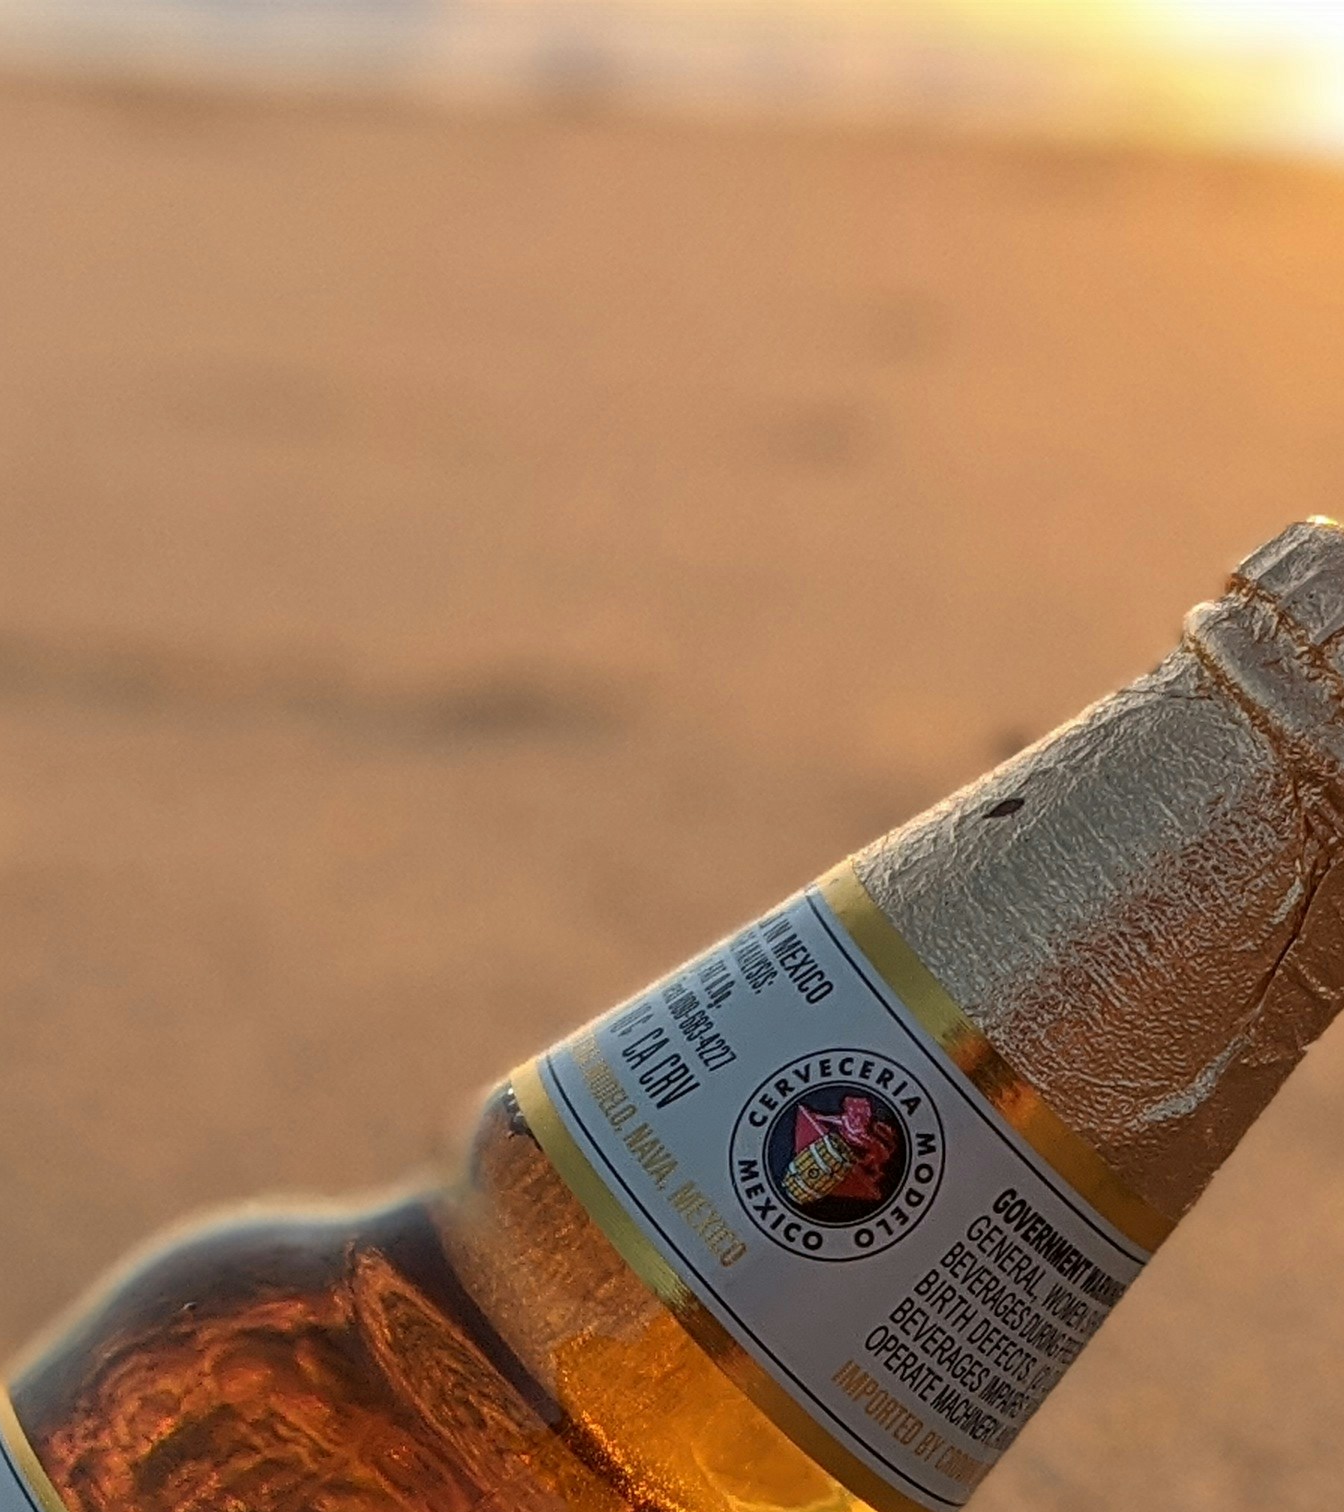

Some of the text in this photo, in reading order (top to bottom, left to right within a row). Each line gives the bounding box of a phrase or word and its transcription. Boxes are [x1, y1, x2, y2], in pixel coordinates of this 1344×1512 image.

[776, 934, 834, 1004] MEXICO
[620, 1026, 672, 1070] CA
[638, 1053, 700, 1110] CRV
[623, 1122, 679, 1192] NAVA,
[667, 1180, 748, 1268] MEXICO
[748, 1057, 936, 1248] CERVECERIA MODELO
[738, 1159, 823, 1250] MEXICO
[992, 1188, 1093, 1284] GOVERNMENT
[913, 1268, 978, 1333] BIRTH
[940, 1241, 1032, 1330] BEVERAGES
[966, 1214, 1046, 1302] GENERAL,
[864, 1324, 943, 1402] OPERATE
[889, 1296, 990, 1393] BEVERAGES
[831, 1359, 924, 1446] IMPORTED
[914, 1431, 944, 1464] BY
